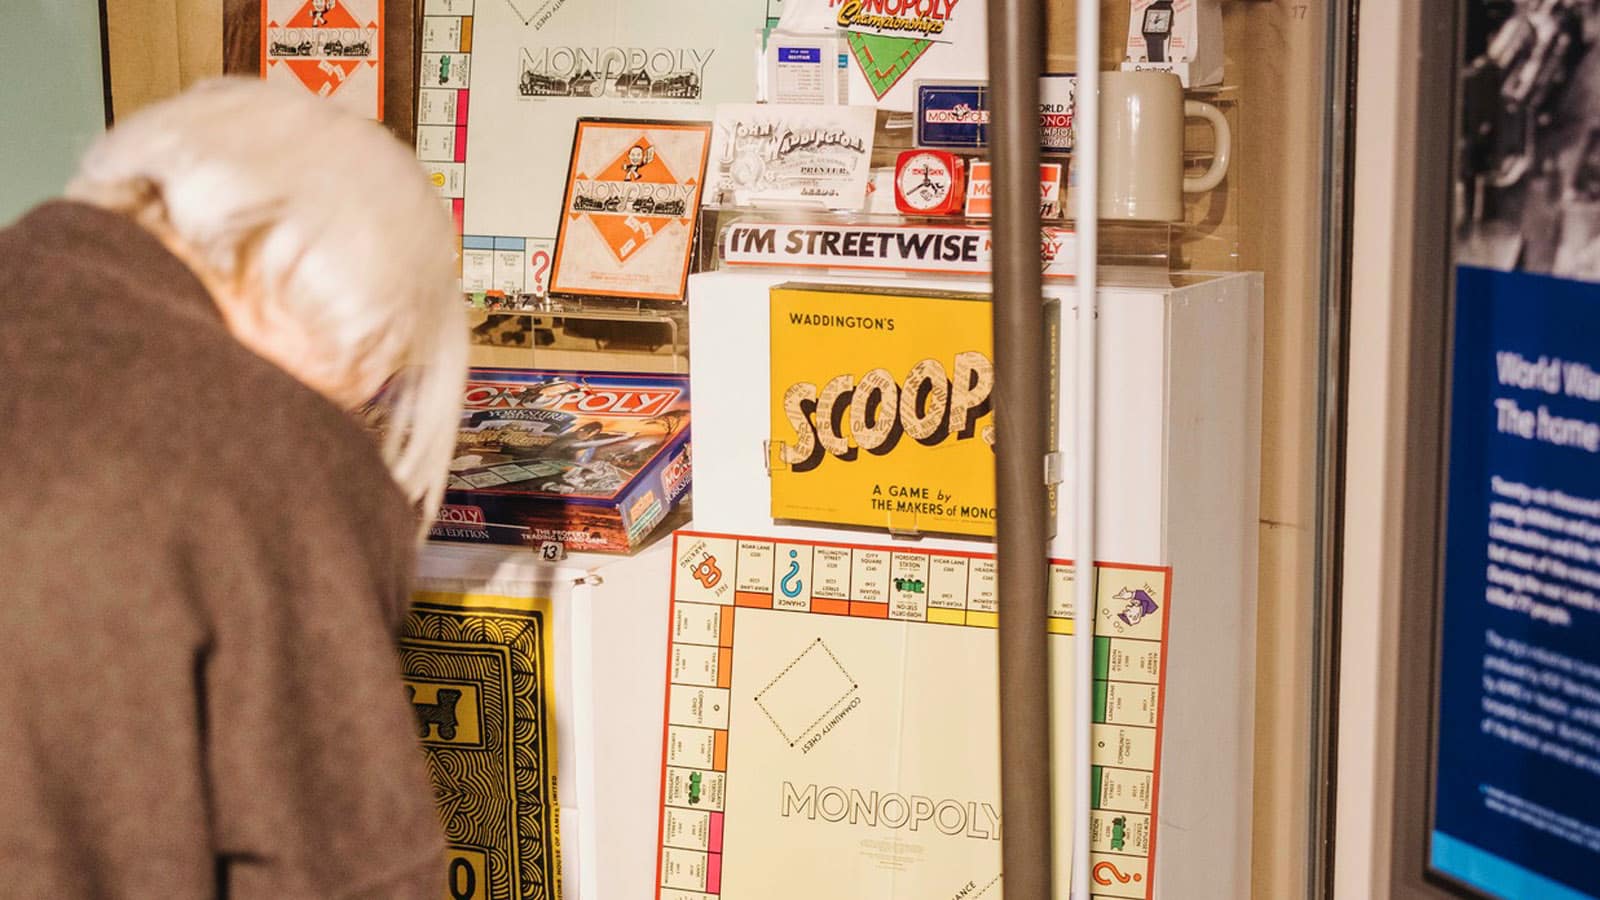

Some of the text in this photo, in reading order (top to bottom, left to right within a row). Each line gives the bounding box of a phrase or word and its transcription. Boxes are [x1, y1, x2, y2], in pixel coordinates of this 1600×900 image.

[837, 0, 945, 36] Championships
[270, 29, 375, 56] MONOPOLY
[518, 46, 715, 100] MONOPOLY
[1040, 104, 1064, 113] ORLD
[574, 181, 696, 215] MONOPOLY
[731, 228, 776, 254] I'M
[785, 229, 979, 262] STREETWISE
[789, 312, 895, 331] WADDINGTON'S
[1496, 350, 1560, 395] World
[464, 386, 669, 413] ONOPOLY
[780, 351, 996, 470] SCOOP
[1494, 398, 1600, 453] The home
[871, 499, 996, 520] THE MAKERS of MONO
[873, 485, 951, 503] A GAME by
[446, 529, 489, 539] EDITION
[542, 545, 558, 560] 13
[778, 599, 806, 608] CHANCE
[1102, 581, 1157, 634] GO TO JAIL
[801, 696, 861, 755] COMMUNITY CHEST
[1117, 730, 1125, 765] COMMUNITY
[781, 781, 1002, 841] MONOPOLY
[952, 880, 976, 900] ANCE
